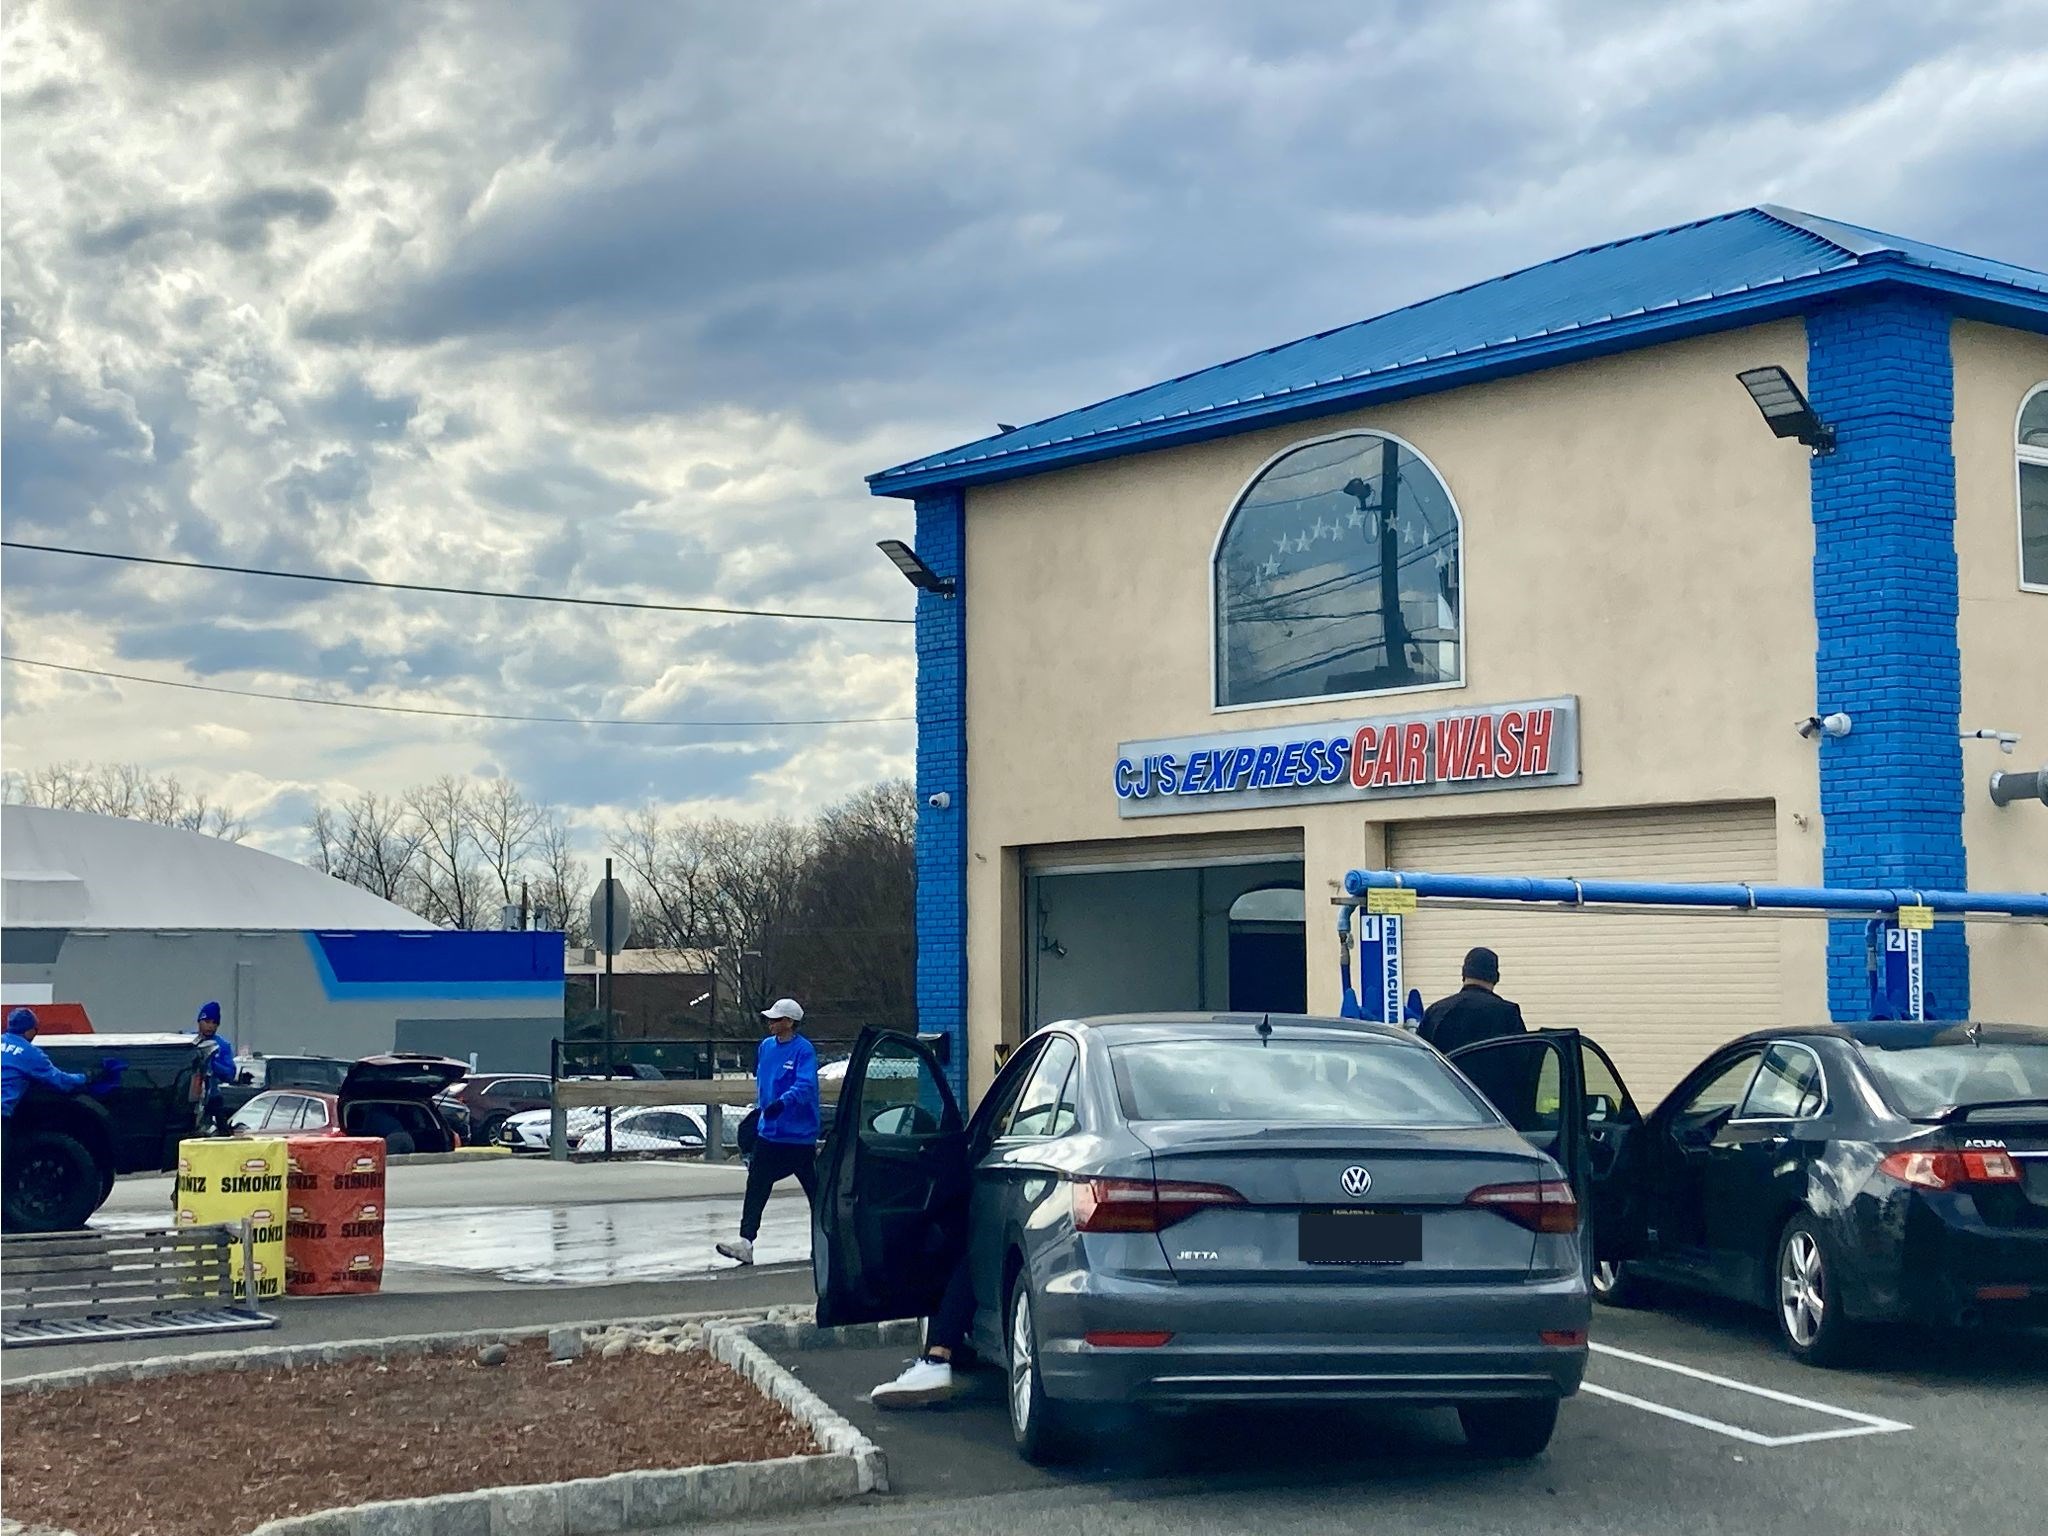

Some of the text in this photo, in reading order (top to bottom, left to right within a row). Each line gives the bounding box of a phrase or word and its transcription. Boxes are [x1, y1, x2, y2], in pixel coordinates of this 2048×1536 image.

[1114, 708, 1556, 799] CJ'S EXPRESS CAR WASH
[1365, 917, 1373, 939] 1
[1891, 931, 1901, 950] 2
[1911, 932, 1919, 964] FREE
[1386, 917, 1399, 1024] FREE VACUUM
[1964, 1139, 2007, 1148] ACURA
[221, 1174, 282, 1192] SIMONIZ
[1177, 1250, 1218, 1261] JETTA
